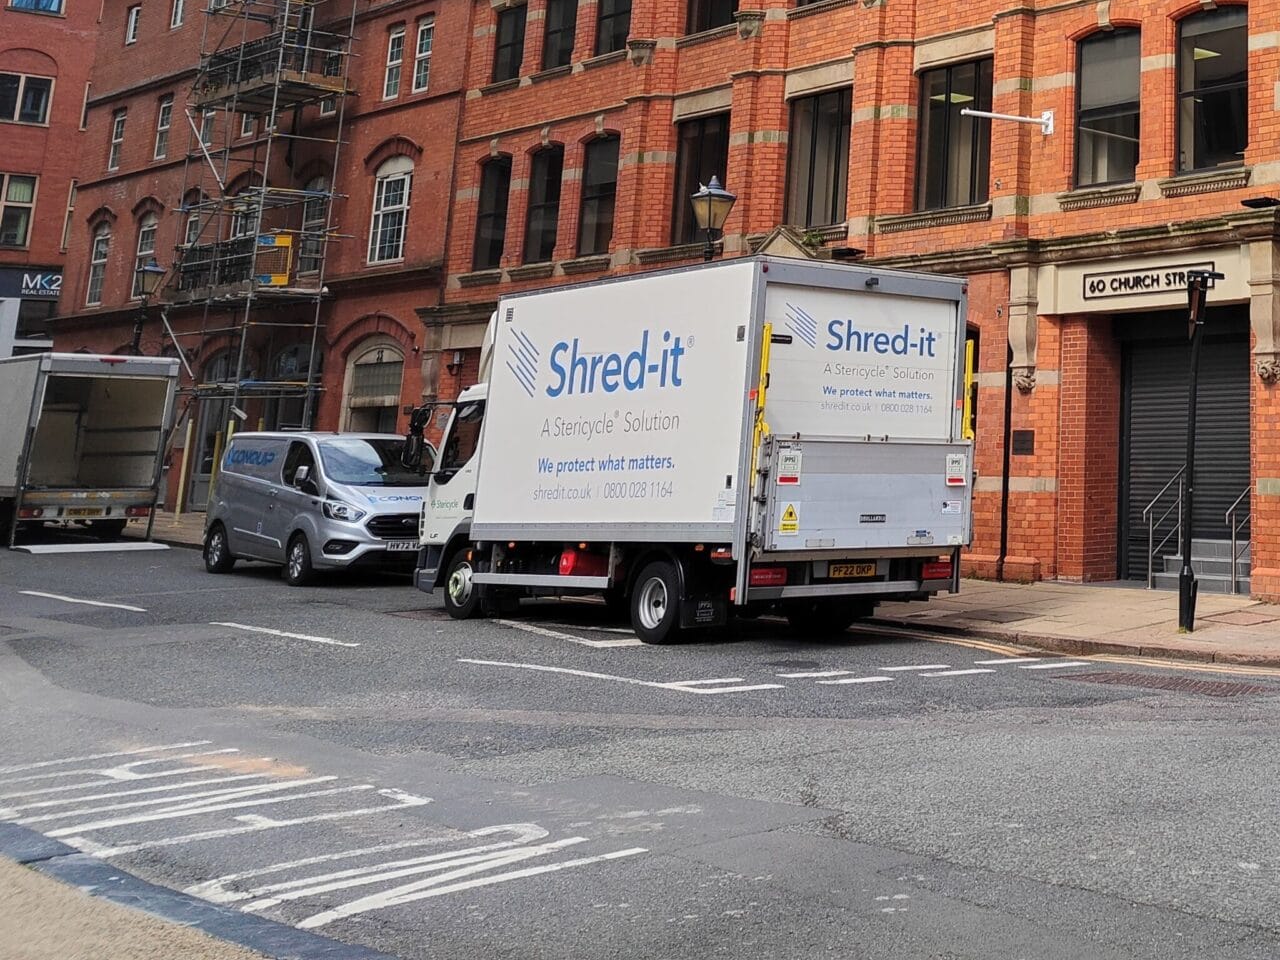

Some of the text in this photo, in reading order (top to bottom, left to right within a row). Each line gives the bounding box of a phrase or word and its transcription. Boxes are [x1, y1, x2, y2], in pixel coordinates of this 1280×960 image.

[1089, 279, 1105, 294] 60
[1110, 274, 1160, 291] CHURCH
[826, 319, 936, 357] Shred-it
[545, 330, 685, 397] Shred-it
[823, 363, 832, 375] A
[892, 367, 935, 381] Solution
[822, 386, 934, 401] We protect what matters.
[880, 403, 900, 414] 0800
[900, 404, 914, 414] 028
[541, 418, 551, 438] A
[623, 409, 680, 433] Solution
[538, 454, 675, 477] We protect what matters.
[603, 481, 627, 500] 0800
[628, 481, 647, 499] 028
[650, 480, 674, 499] 1164
[832, 566, 854, 576] PF22
